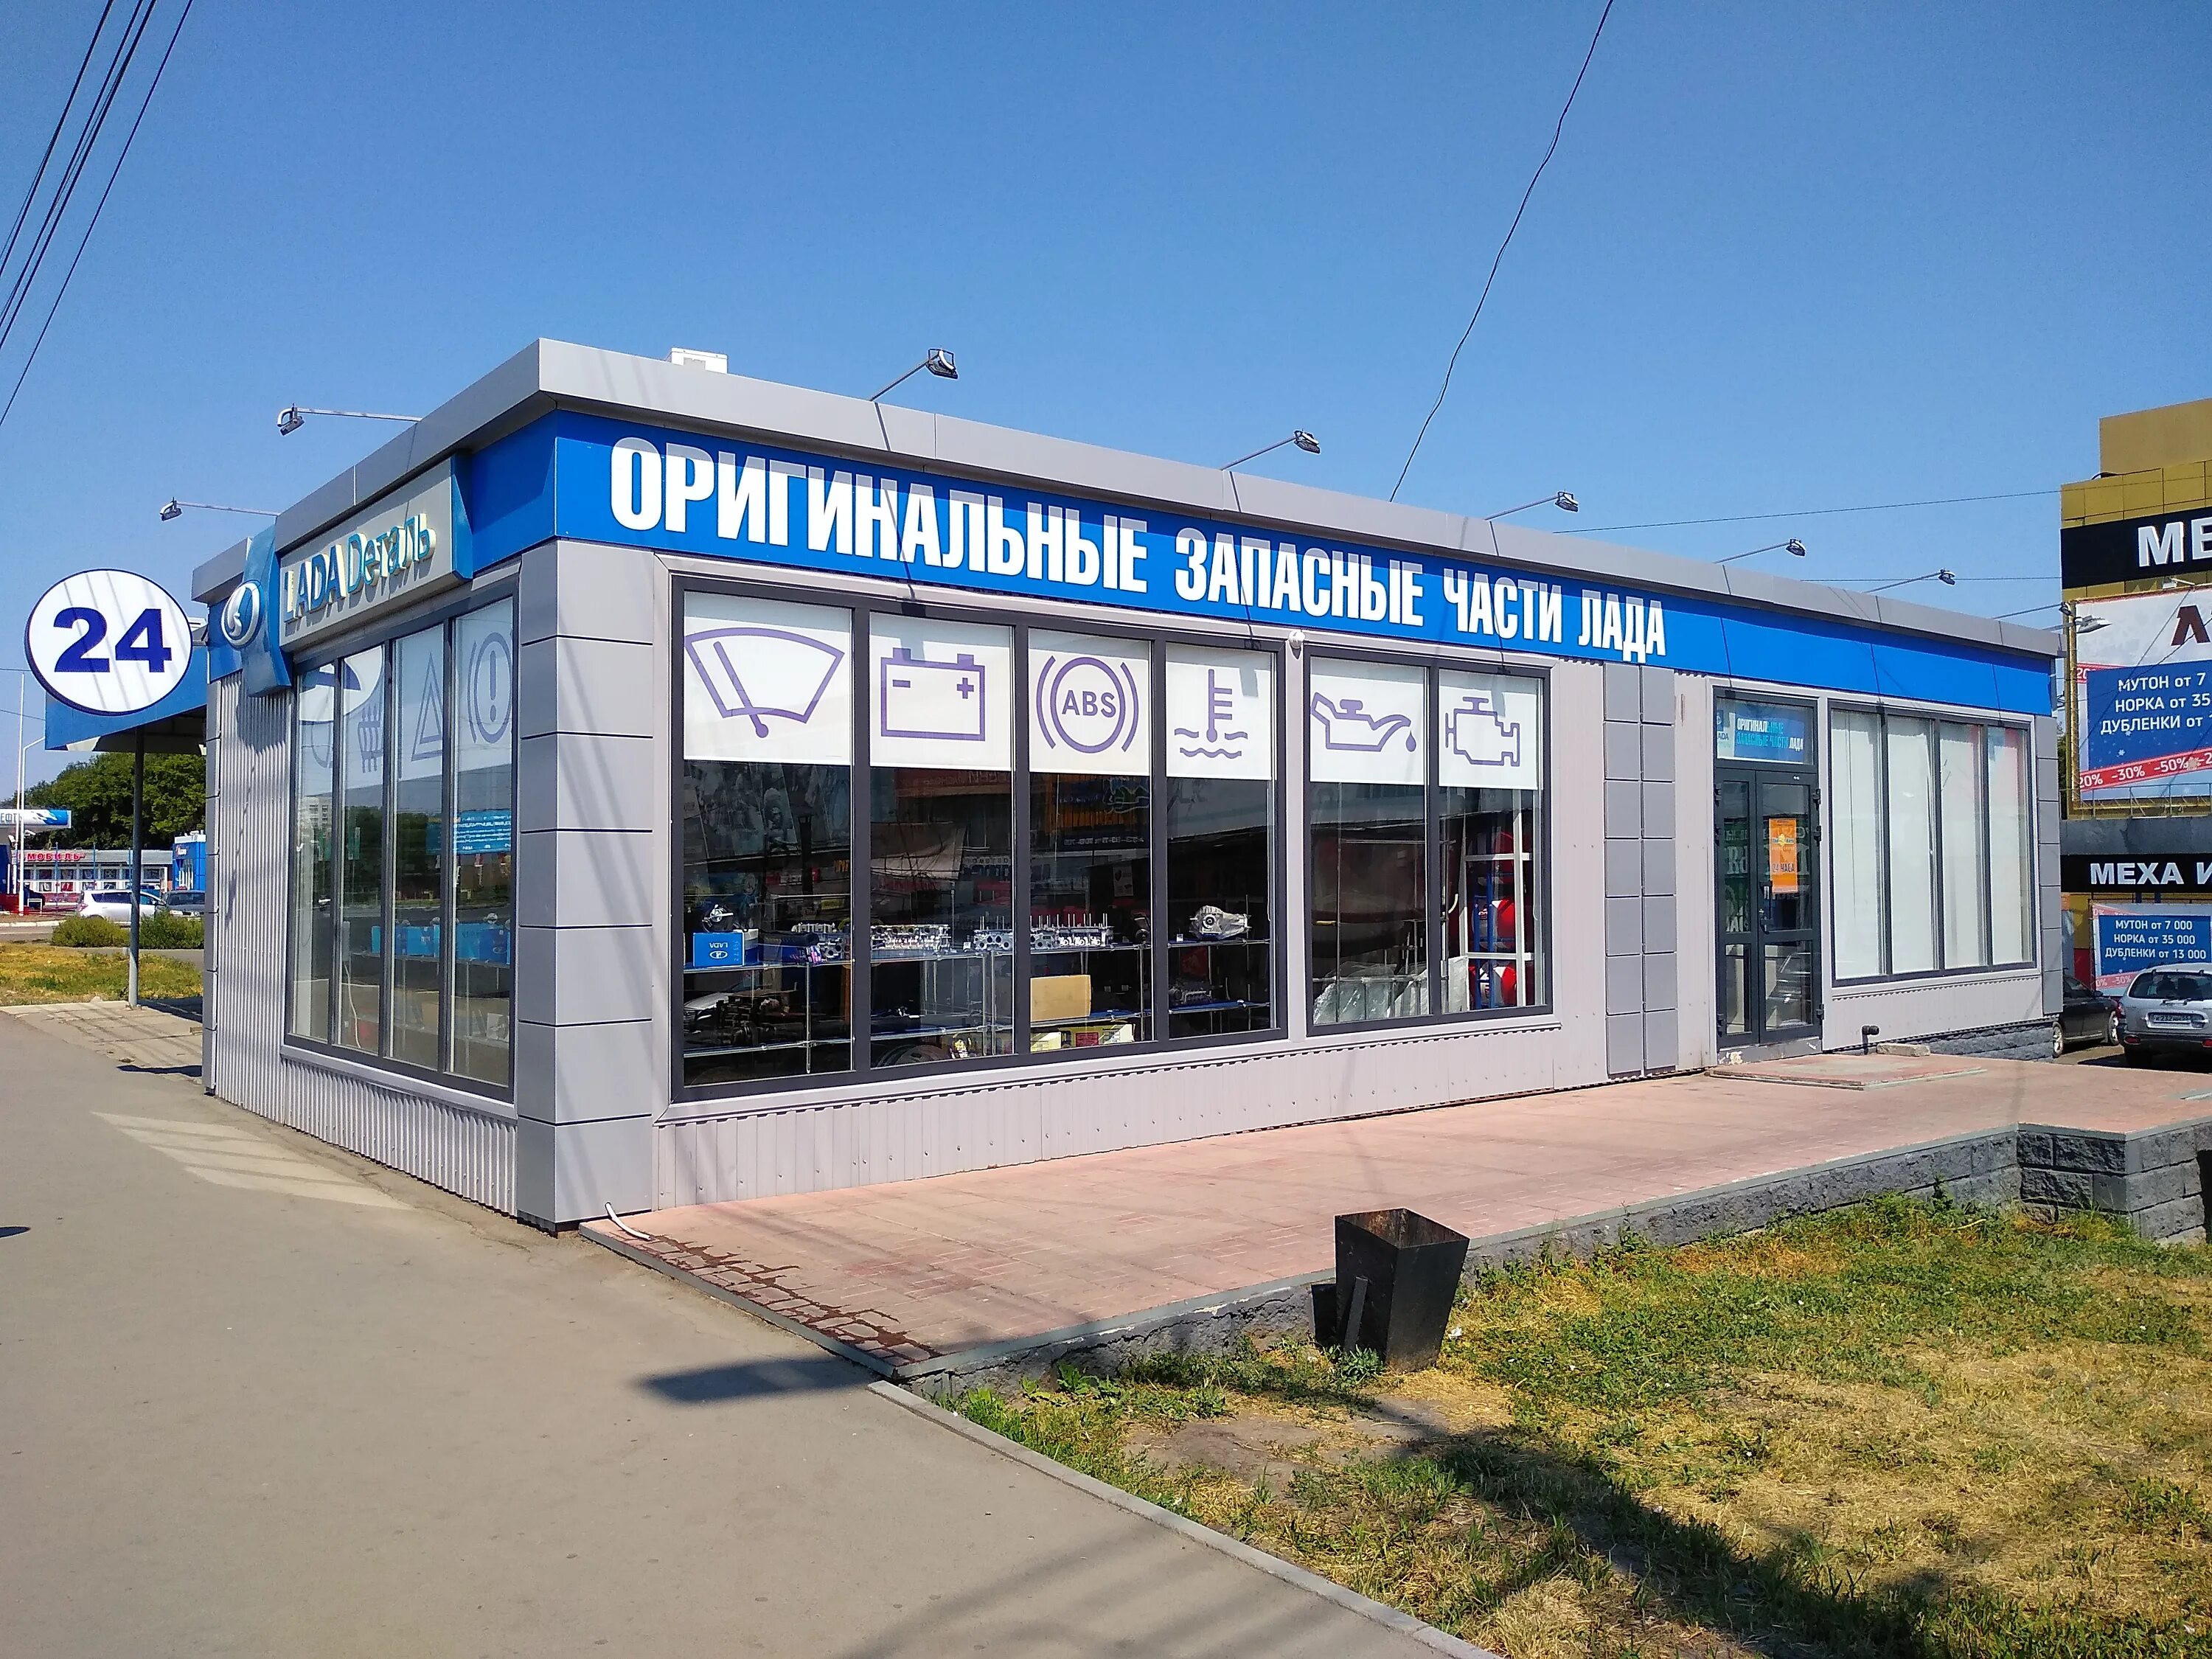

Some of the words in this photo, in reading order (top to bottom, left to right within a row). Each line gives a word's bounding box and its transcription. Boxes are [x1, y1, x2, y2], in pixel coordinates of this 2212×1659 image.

[611, 437, 1148, 593] ОРИГИНАЛЬНЫЕ
[1175, 527, 1425, 627] ЗАПАСНЫЕ
[1443, 568, 1562, 644] ЧАСТИ
[1578, 590, 1666, 662] ЛАДА
[284, 544, 347, 622] LADA
[53, 607, 173, 672] 24
[2118, 675, 2169, 692] МУТОН
[2174, 677, 2191, 688] от
[2197, 672, 2206, 686] 7
[1061, 689, 1116, 718] ABS
[2115, 697, 2165, 712] НОРКА
[2169, 698, 2186, 709] от
[2191, 693, 2211, 707] 35
[2101, 715, 2180, 735] ДУБЛЕНКИ
[2186, 717, 2203, 728] от
[1717, 731, 1729, 741] ADA
[1789, 737, 1804, 752] ЛАДА
[2111, 765, 2146, 782] -30%
[2090, 862, 2184, 885] МЕХА
[2115, 920, 2148, 930] МУТОН
[2165, 921, 2170, 931] 7
[2174, 921, 2193, 931] 000
[2113, 933, 2146, 944] НОРКА
[2149, 936, 2159, 944] от
[2162, 935, 2174, 944] 35
[2177, 935, 2195, 945] 000
[2105, 947, 2156, 958] ДУБЛЕНКИ
[2158, 950, 2169, 959] от
[2173, 950, 2185, 959] 13
[2188, 950, 2207, 959] 000
